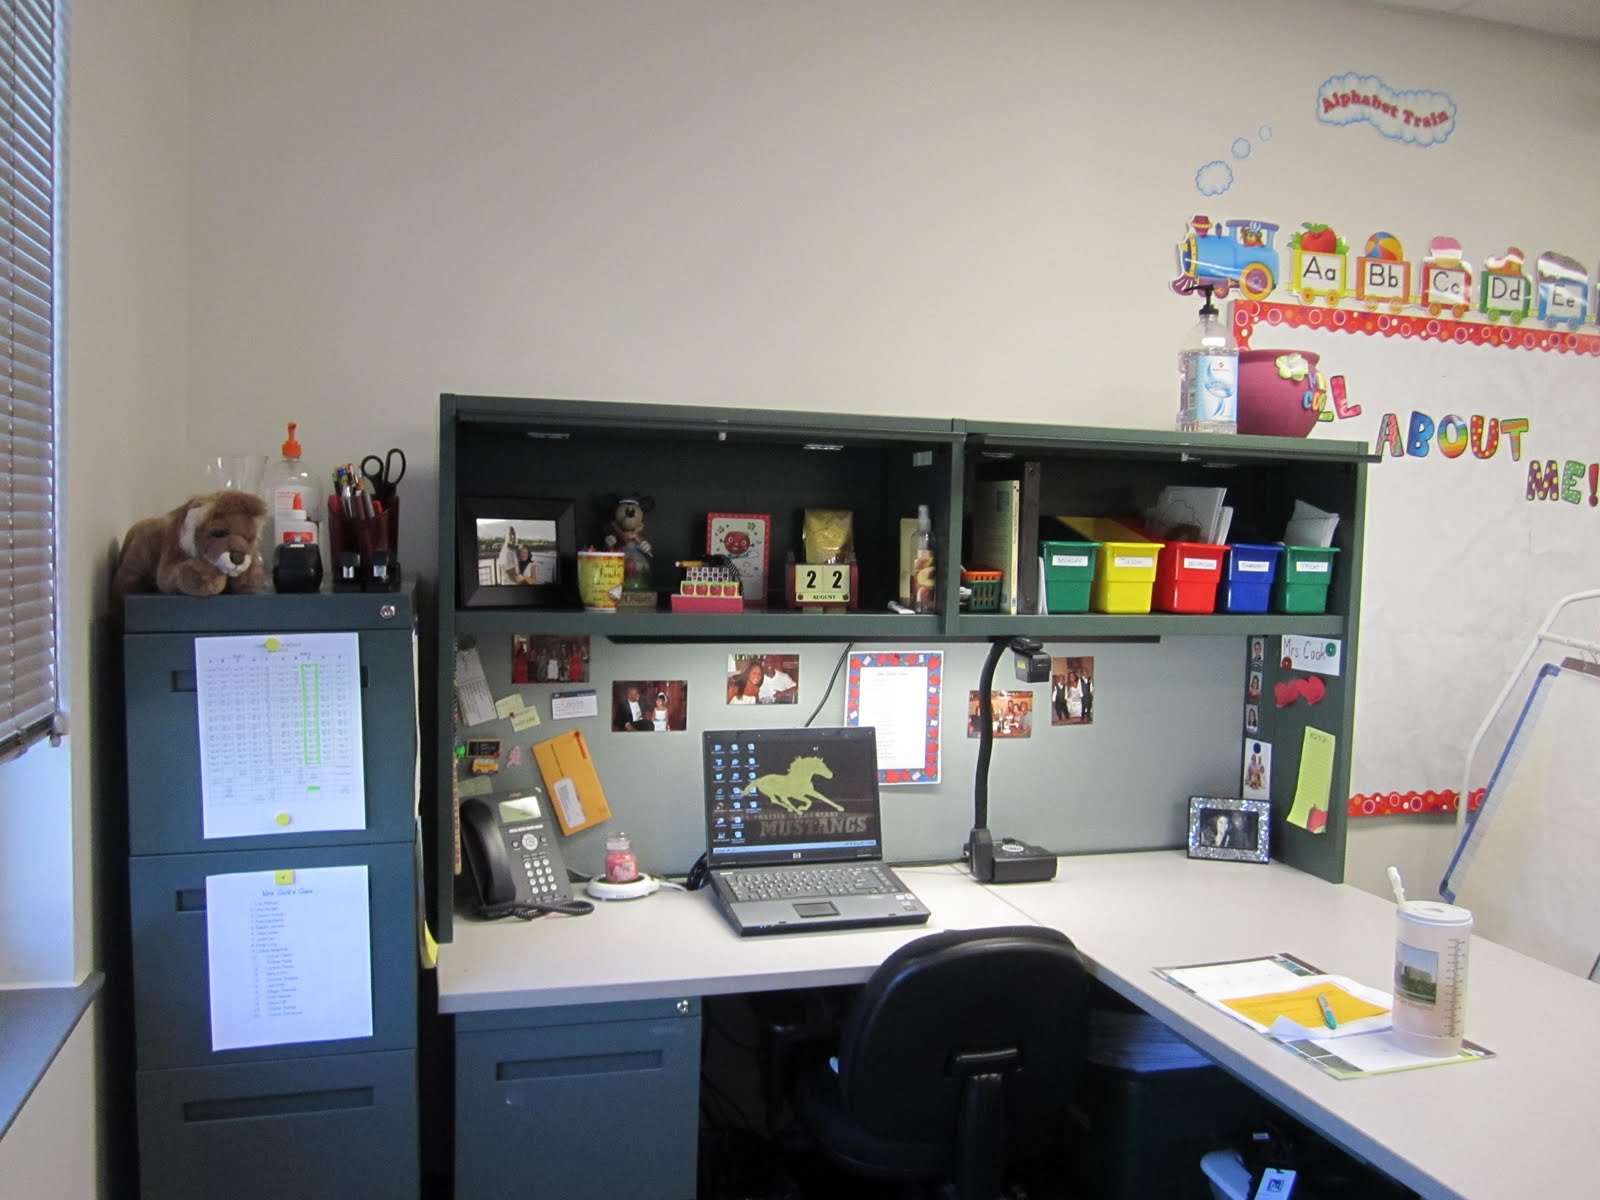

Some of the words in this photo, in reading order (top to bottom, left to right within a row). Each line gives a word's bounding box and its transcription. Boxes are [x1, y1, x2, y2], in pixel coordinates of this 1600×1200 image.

[1322, 89, 1398, 118] Alphabet
[1403, 109, 1449, 127] Train
[1303, 256, 1336, 281] Aa
[1369, 263, 1398, 288] Bb
[1433, 271, 1460, 295] Cc
[1491, 277, 1521, 301] Dd
[1552, 284, 1575, 308] Ee
[1375, 410, 1529, 461] ABOUT
[1526, 459, 1600, 508] ME!
[1283, 637, 1299, 658] Mrs
[1303, 640, 1326, 661] Cook
[760, 815, 869, 836] MUSTANGS
